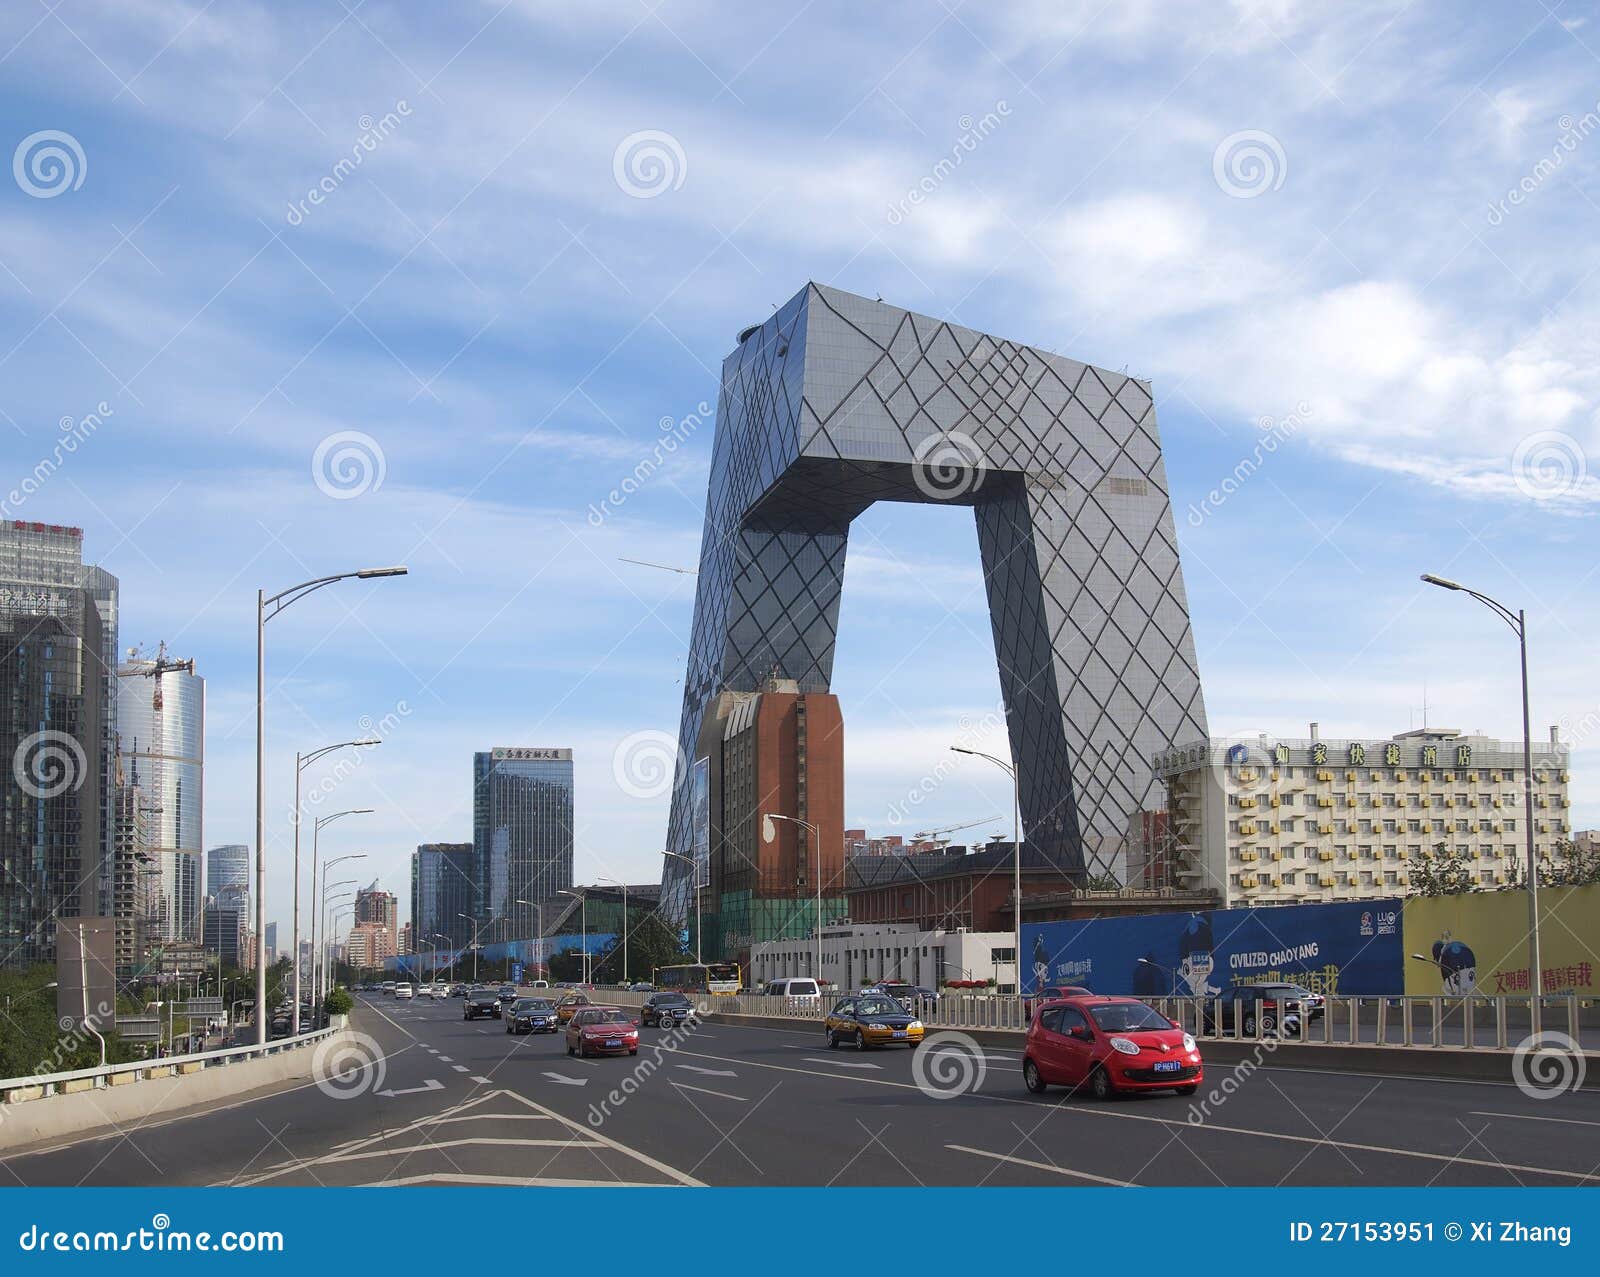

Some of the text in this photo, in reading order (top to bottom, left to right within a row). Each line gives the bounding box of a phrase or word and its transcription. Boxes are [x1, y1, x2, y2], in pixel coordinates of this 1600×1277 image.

[1274, 743, 1473, 766] 如家快捷酒店
[1229, 942, 1319, 968] CIVILIZED CHAOYANG
[1493, 968, 1531, 993] 文明朝
